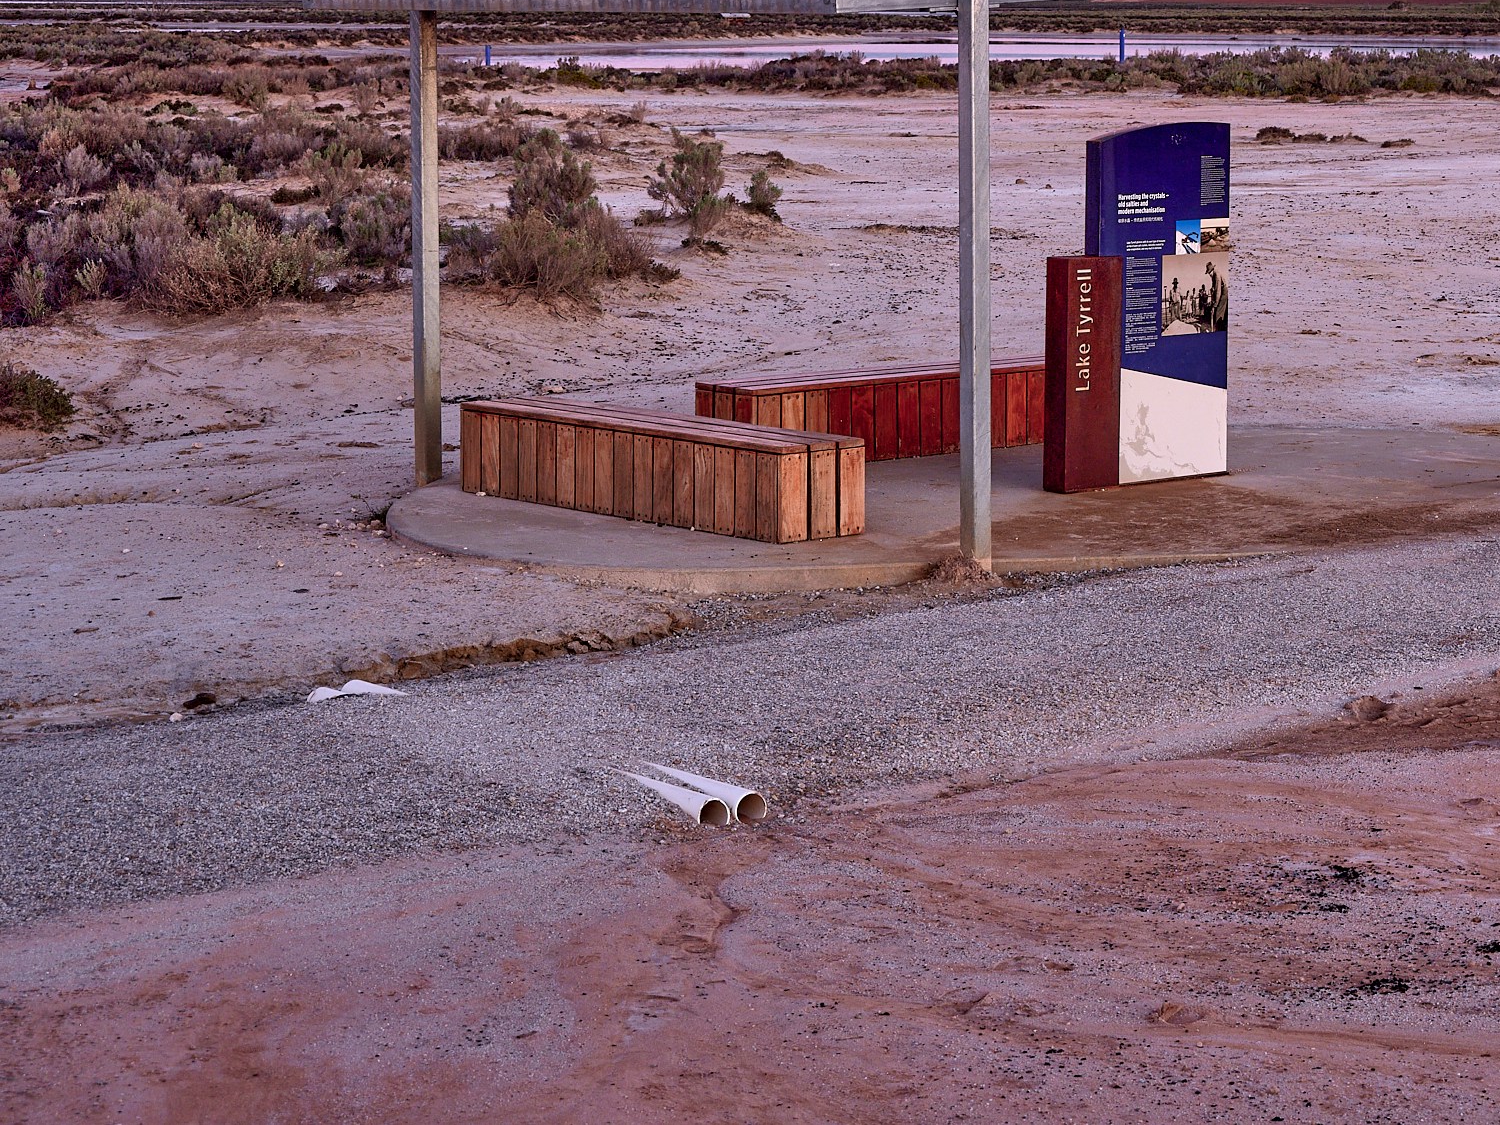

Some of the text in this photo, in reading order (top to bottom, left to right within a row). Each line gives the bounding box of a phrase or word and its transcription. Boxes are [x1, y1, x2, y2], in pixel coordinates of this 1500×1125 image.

[1149, 192, 1165, 200] crystals
[1075, 269, 1093, 391] Lake Tyrrell
